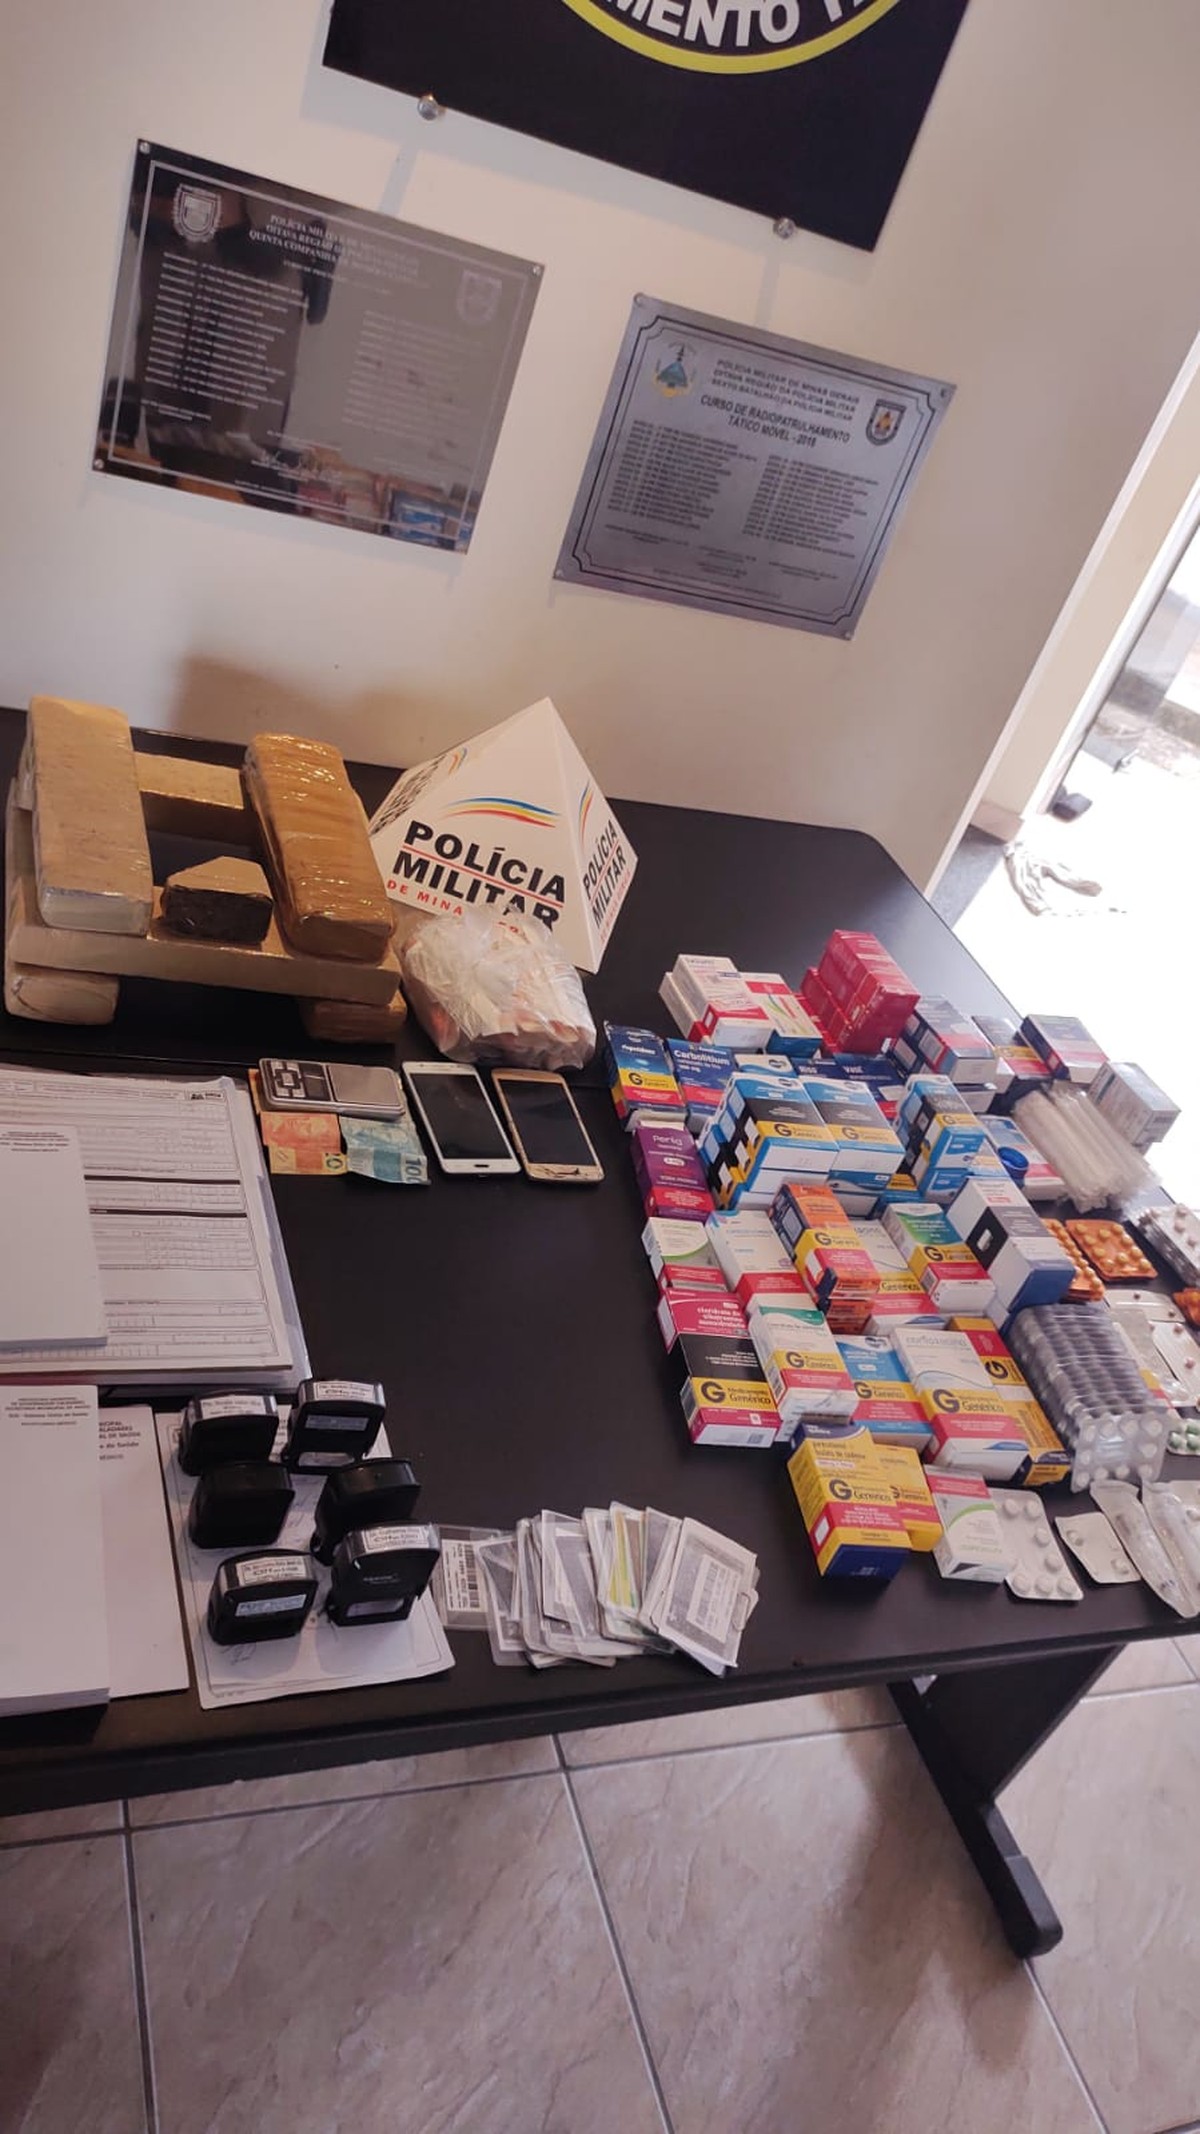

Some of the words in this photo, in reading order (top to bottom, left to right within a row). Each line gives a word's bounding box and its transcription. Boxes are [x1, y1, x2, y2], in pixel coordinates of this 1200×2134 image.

[700, 394, 733, 412] CURSO
[734, 403, 749, 415] DE
[749, 406, 851, 443] RADIOPATRULHAMENTO
[404, 820, 565, 903] POLÍCIA
[583, 819, 618, 900] POLÍCIA
[387, 879, 408, 896] DE
[416, 890, 464, 917] MINA
[393, 851, 561, 932] MILITAR
[592, 845, 627, 929] MILITAR
[701, 1381, 726, 1404] G
[932, 1389, 960, 1413] G
[829, 1478, 853, 1500] G
